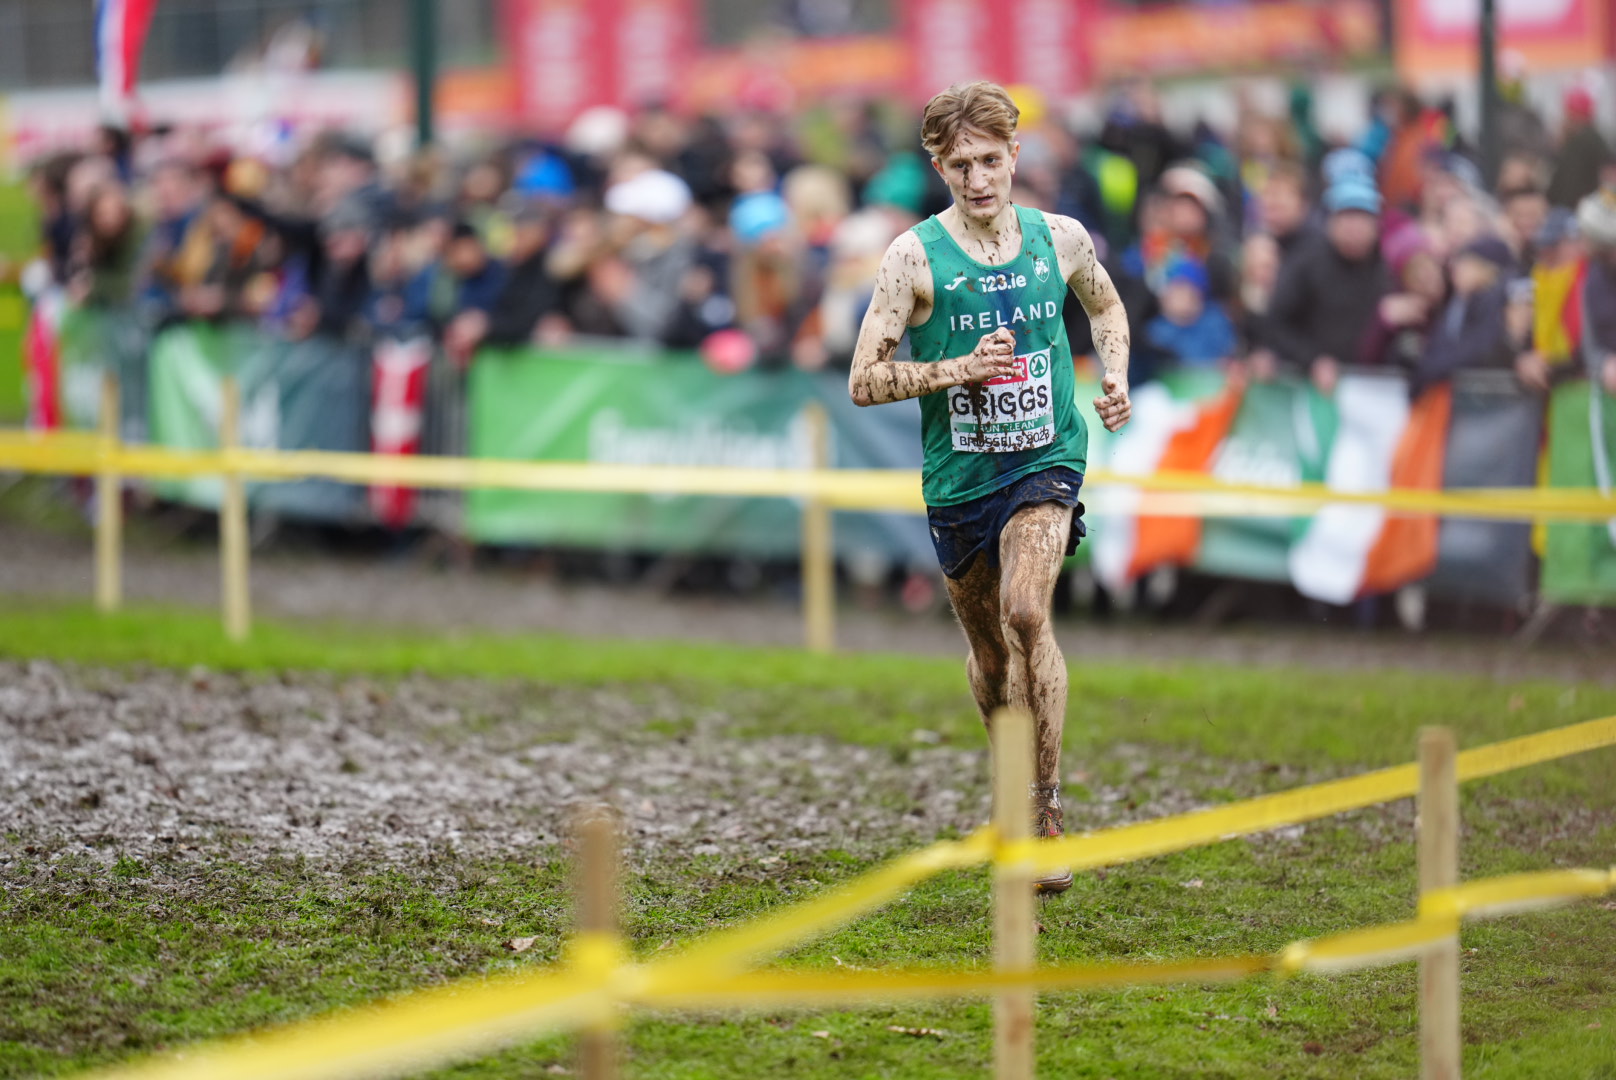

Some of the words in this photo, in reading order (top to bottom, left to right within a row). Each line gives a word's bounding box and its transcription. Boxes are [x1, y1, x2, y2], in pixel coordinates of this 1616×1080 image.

[978, 273, 1027, 293] 123.ie
[950, 301, 1057, 331] IRELAND
[952, 384, 1048, 419] GRIGGS
